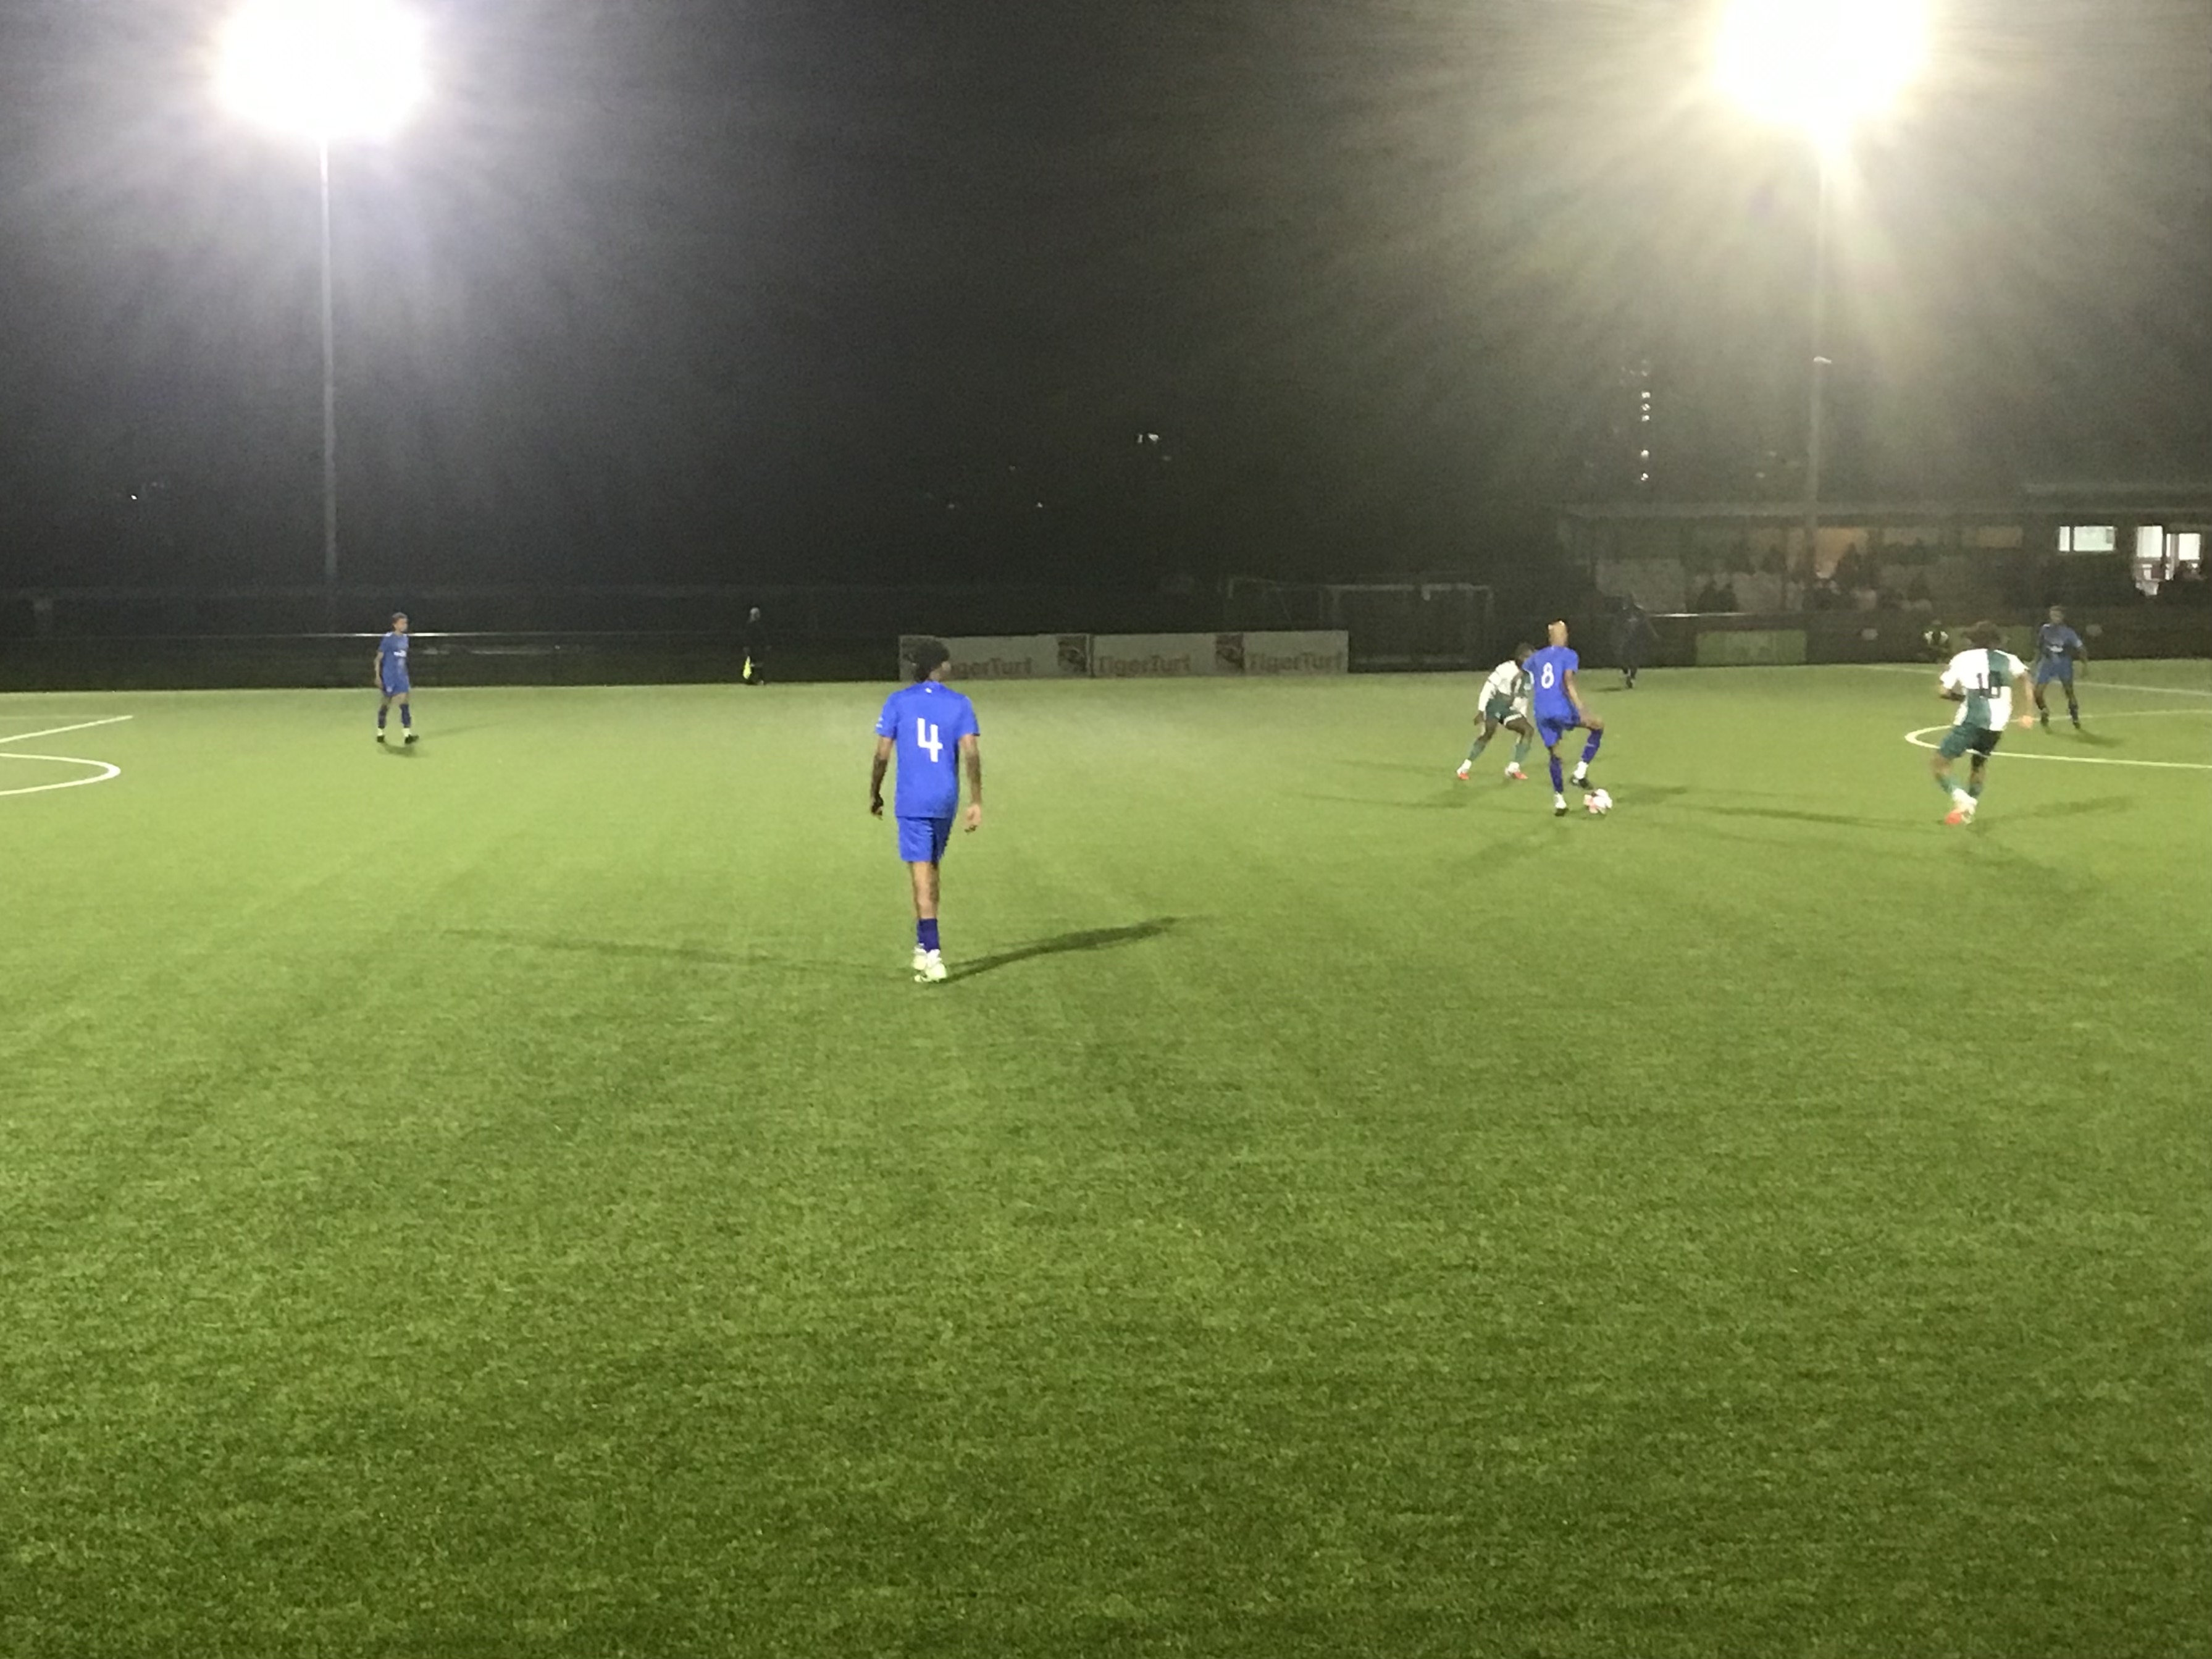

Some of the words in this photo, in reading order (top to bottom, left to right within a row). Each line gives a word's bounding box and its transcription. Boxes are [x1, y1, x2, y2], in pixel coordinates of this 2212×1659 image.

[951, 657, 1032, 678] gerTurf
[1541, 662, 1554, 689] 8
[916, 717, 944, 763] 4
